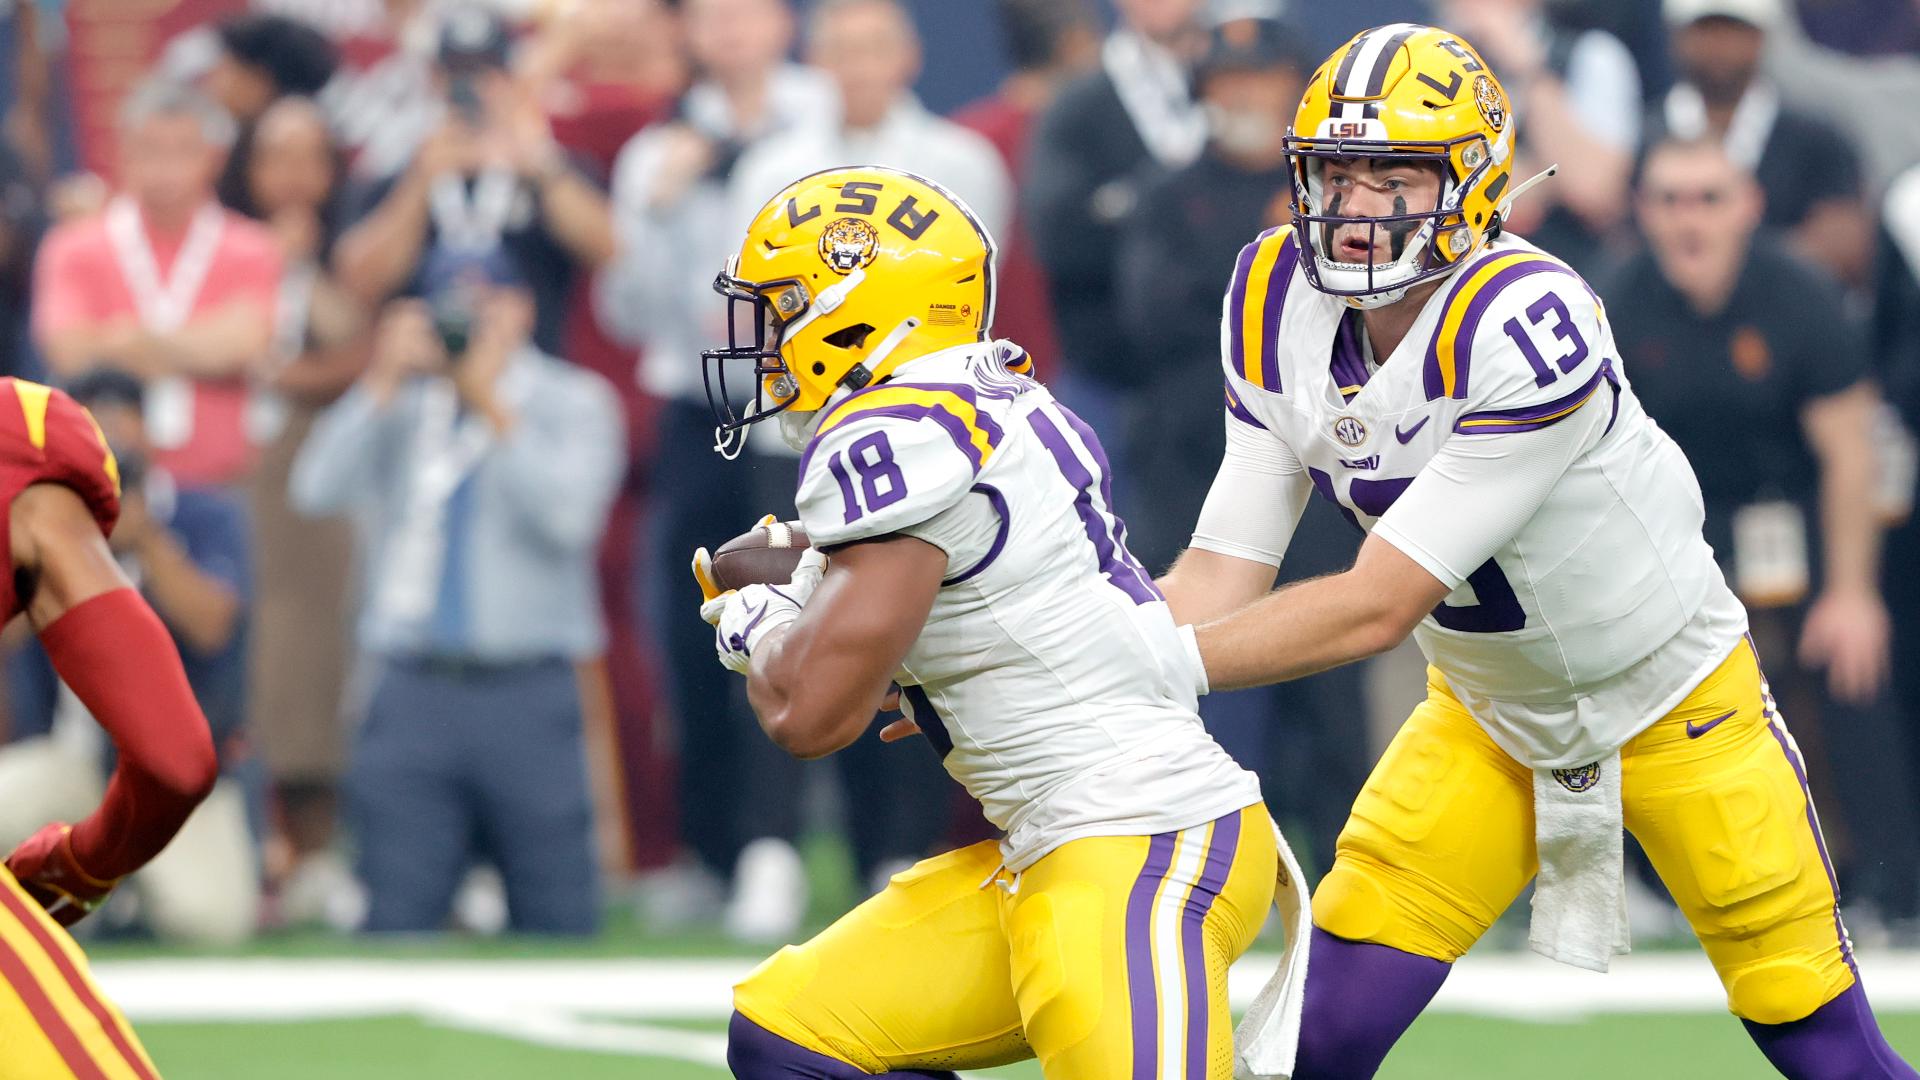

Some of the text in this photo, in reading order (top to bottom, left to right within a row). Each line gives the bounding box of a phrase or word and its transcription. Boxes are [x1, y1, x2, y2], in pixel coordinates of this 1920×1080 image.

[1329, 122, 1367, 139] LSU
[786, 180, 940, 241] LSU
[1503, 291, 1589, 389] 13
[1336, 417, 1366, 446] SEC
[828, 429, 908, 525] 18
[1339, 454, 1380, 471] LSU
